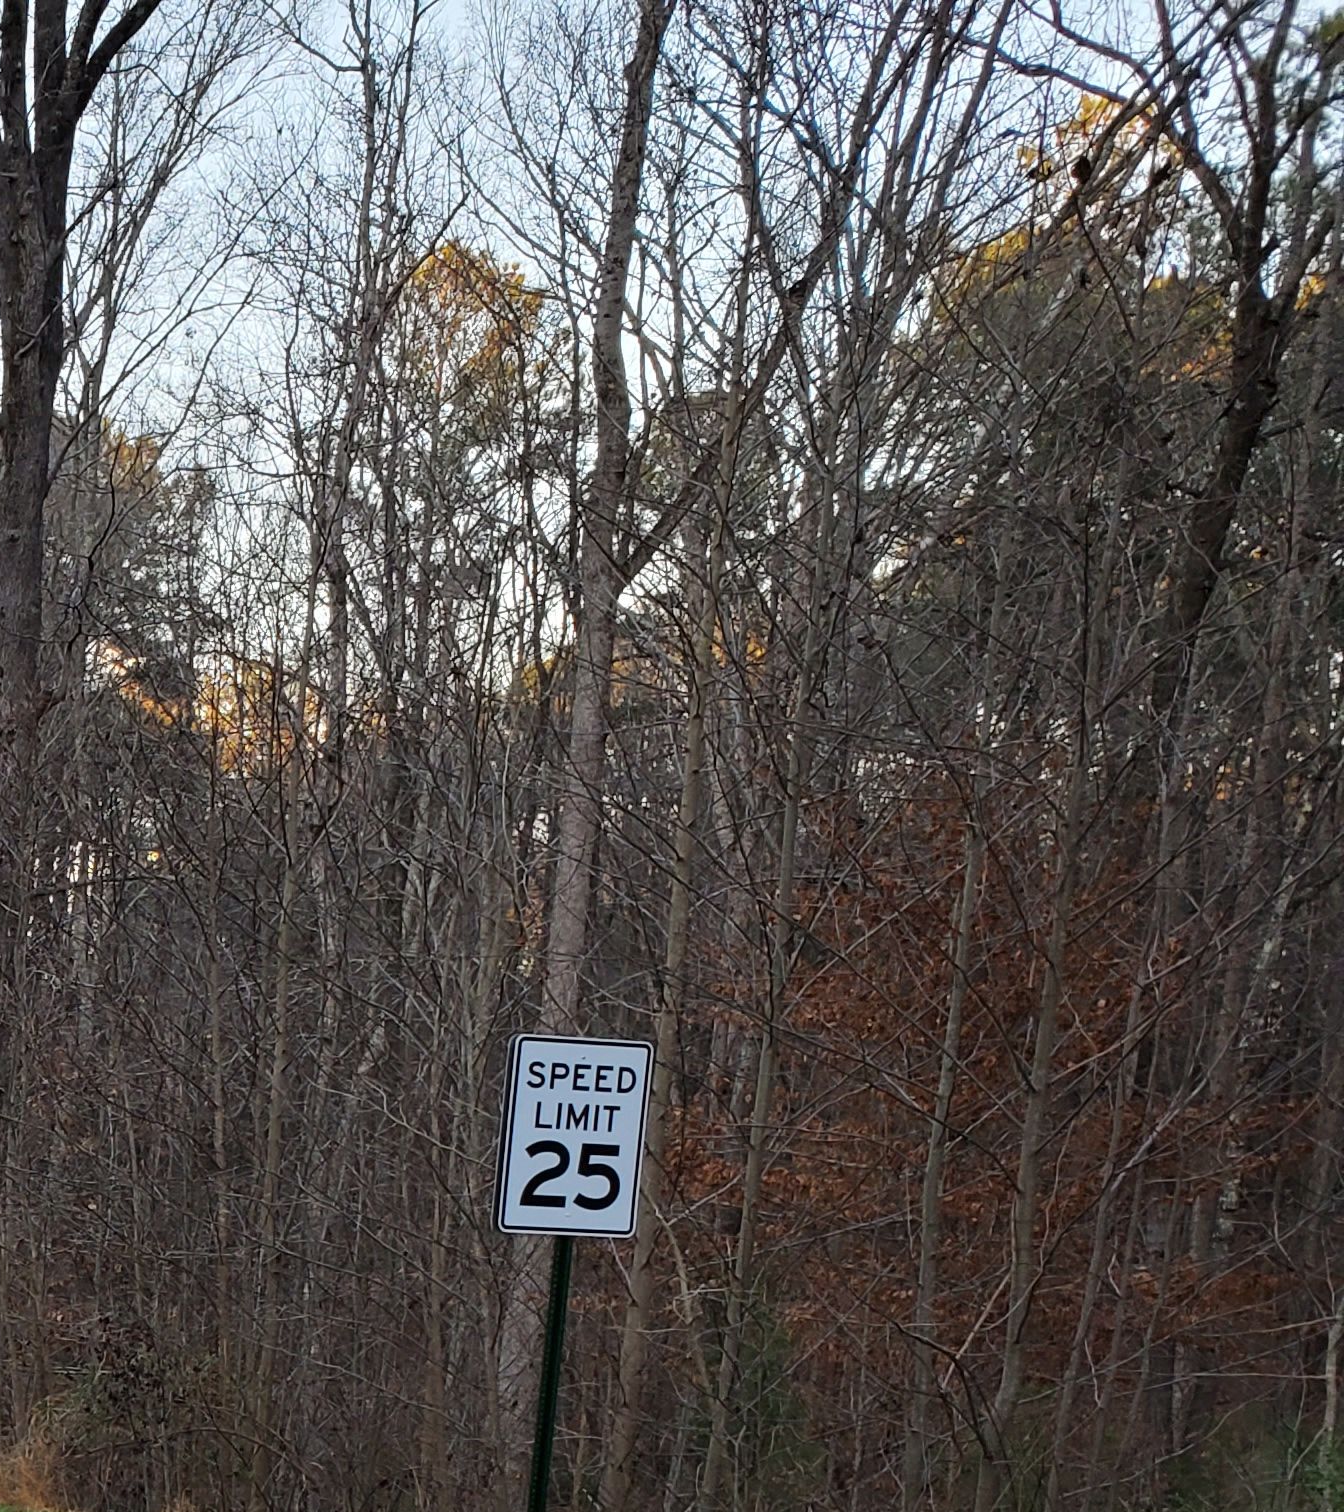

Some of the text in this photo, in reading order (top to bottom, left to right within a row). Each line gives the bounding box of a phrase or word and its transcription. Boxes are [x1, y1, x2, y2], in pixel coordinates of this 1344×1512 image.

[526, 1061, 637, 1094] SPEED
[534, 1101, 621, 1133] LIMIT
[519, 1140, 621, 1211] 25
